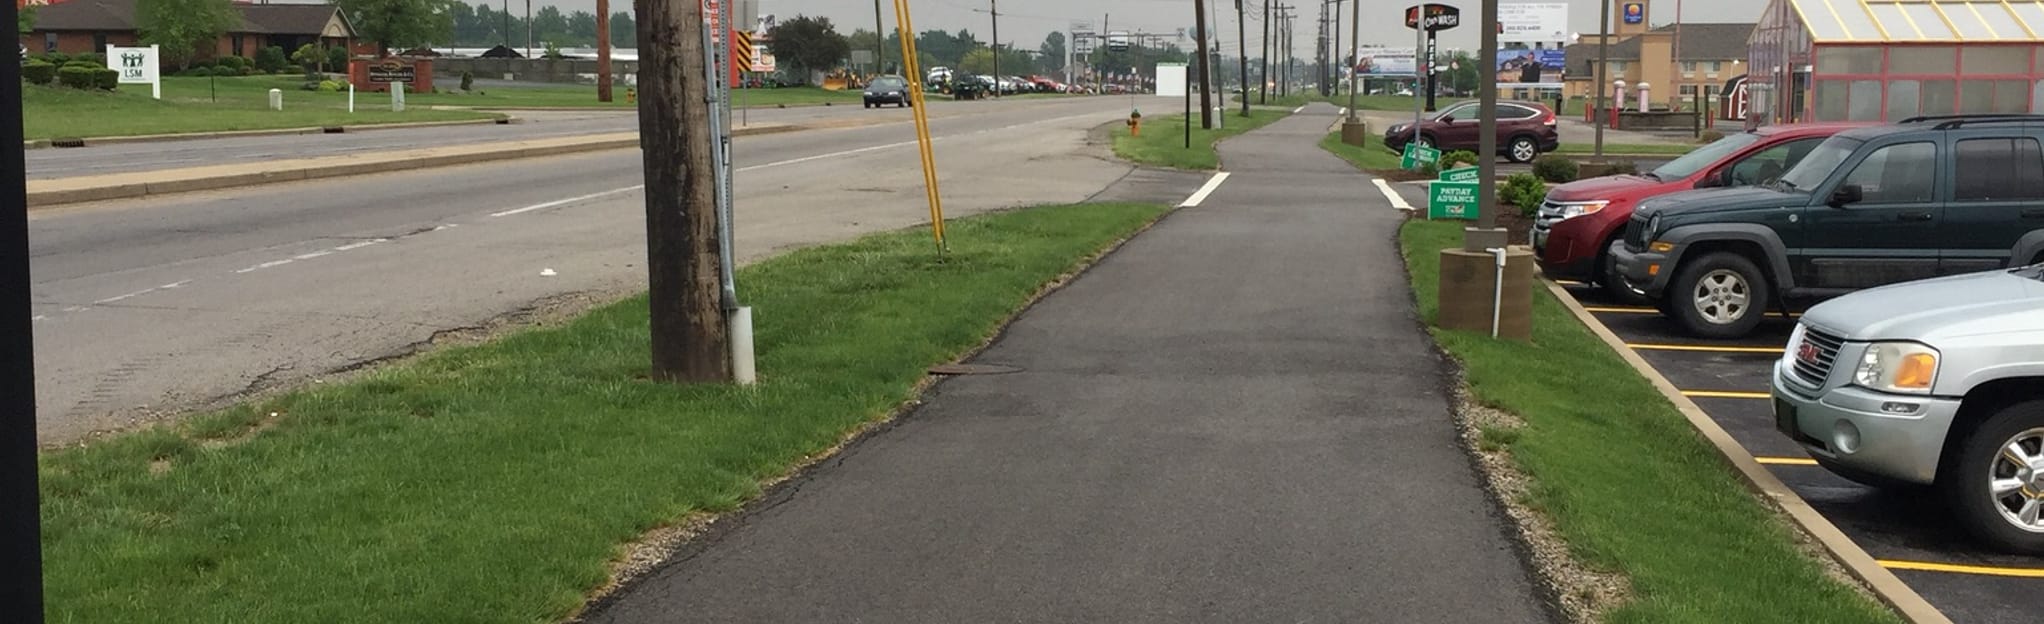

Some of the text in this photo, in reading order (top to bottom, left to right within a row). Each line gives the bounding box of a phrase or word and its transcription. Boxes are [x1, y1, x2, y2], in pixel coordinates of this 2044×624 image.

[1438, 15, 1457, 25] WASH
[125, 69, 142, 77] LSM
[1450, 171, 1477, 181] CHECK
